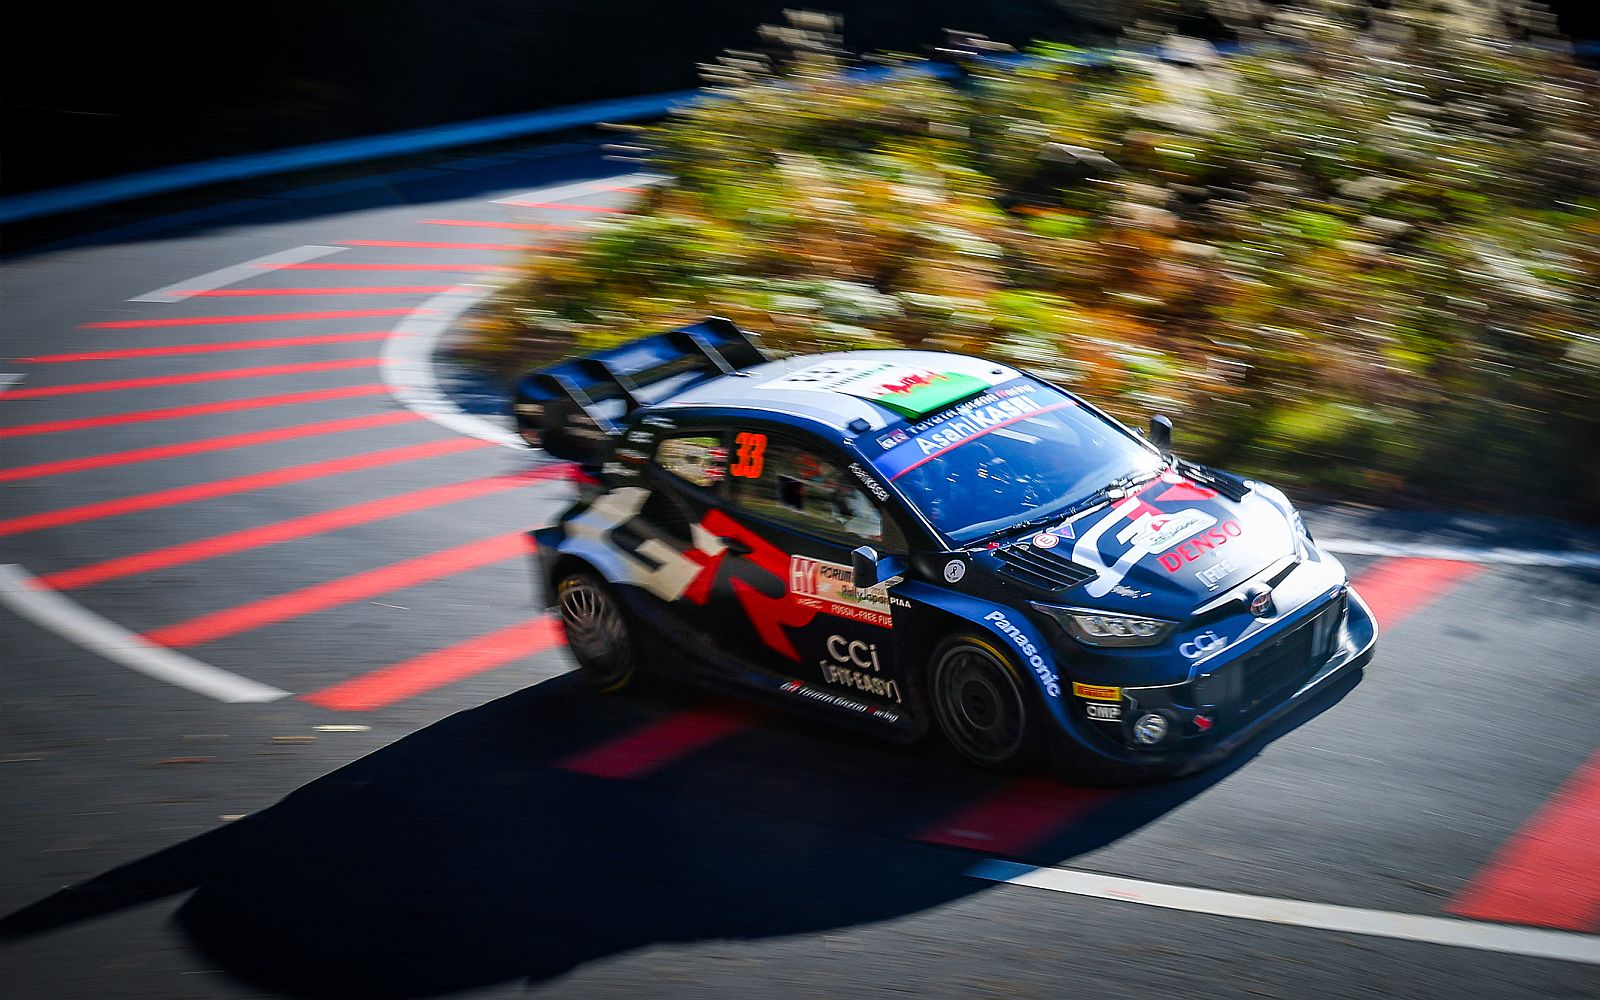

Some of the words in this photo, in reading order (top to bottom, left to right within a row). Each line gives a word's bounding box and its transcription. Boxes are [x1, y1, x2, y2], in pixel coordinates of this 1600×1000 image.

[730, 432, 768, 478] 33
[1156, 520, 1243, 574] DENSO
[890, 597, 912, 609] PIAA
[984, 611, 1061, 698] Panasonic
[1086, 704, 1122, 719] OMP
